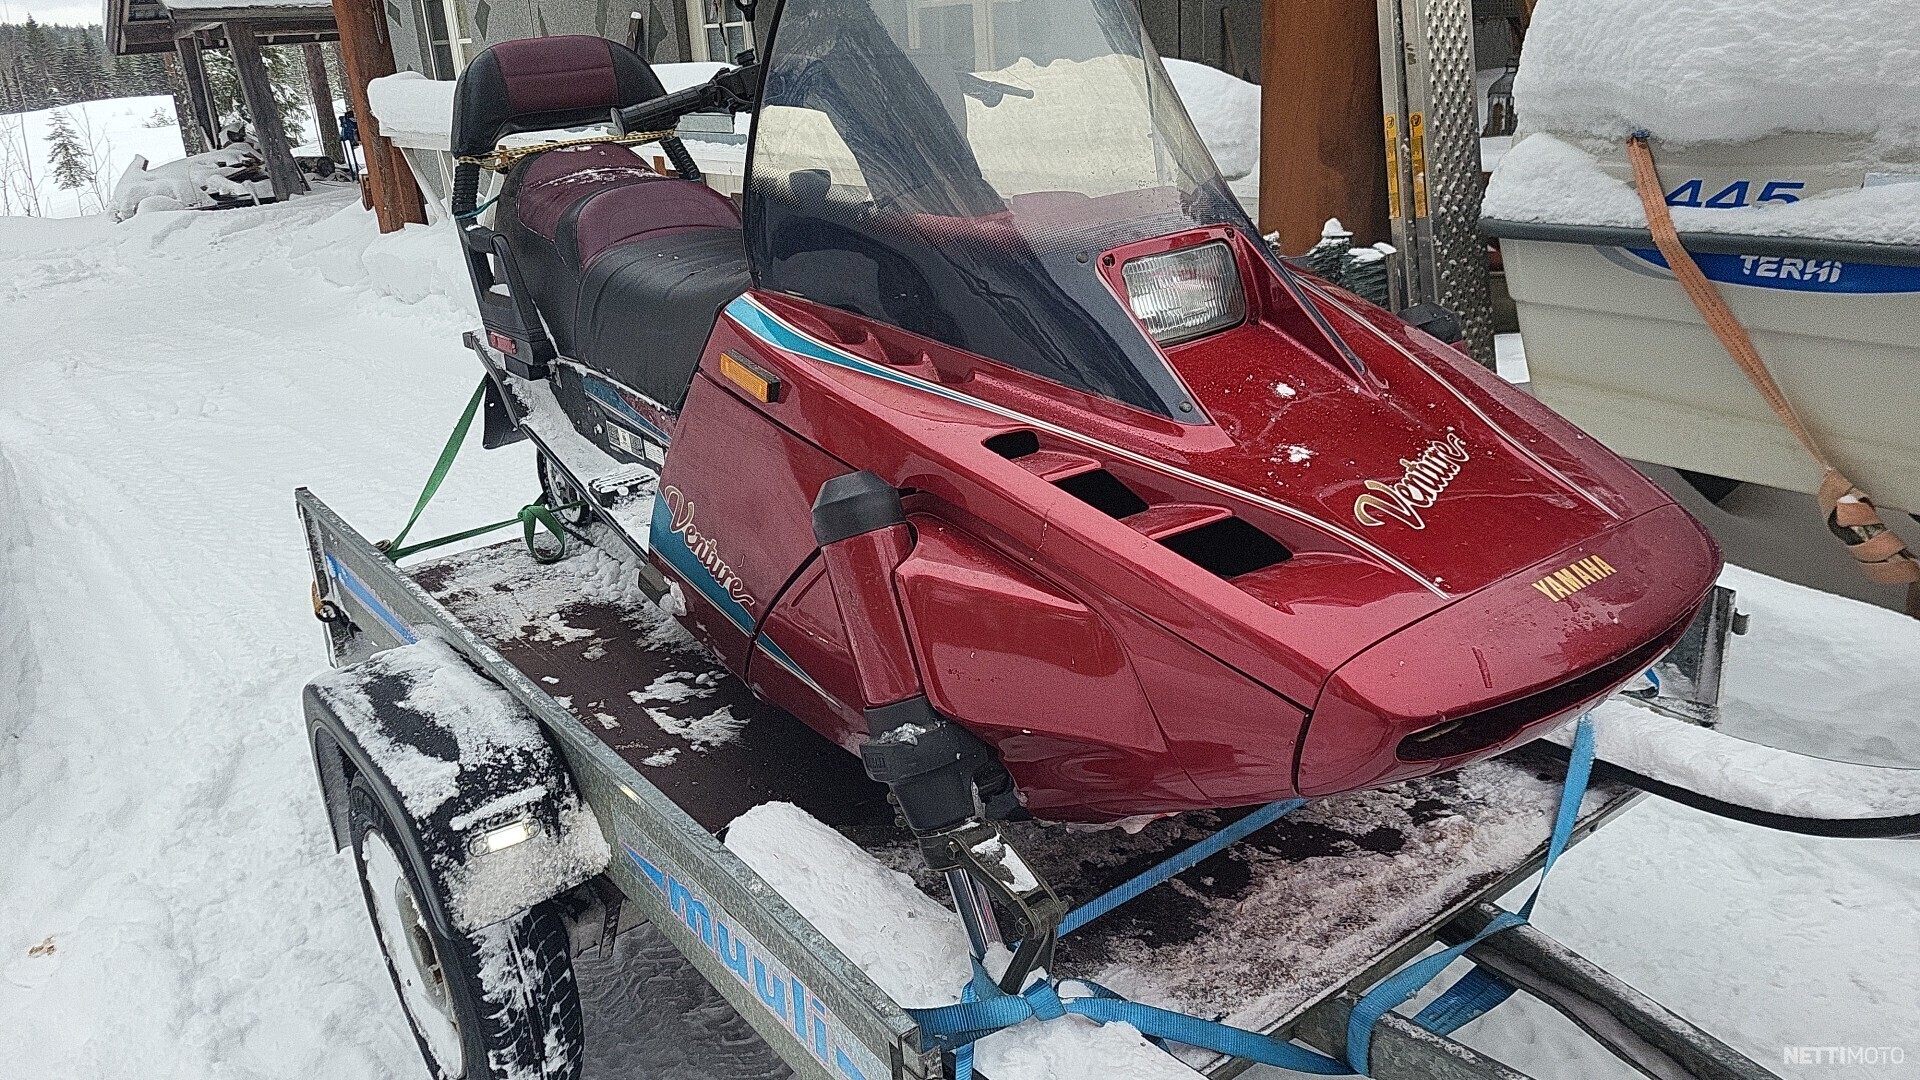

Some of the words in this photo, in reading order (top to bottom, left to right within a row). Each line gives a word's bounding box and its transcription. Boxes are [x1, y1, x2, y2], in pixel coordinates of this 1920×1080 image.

[1740, 255, 1842, 284] TERHI
[1354, 432, 1470, 530] Venture
[664, 485, 755, 607] Venture
[1531, 554, 1618, 603] YAMAHA
[666, 871, 831, 1068] muuli
